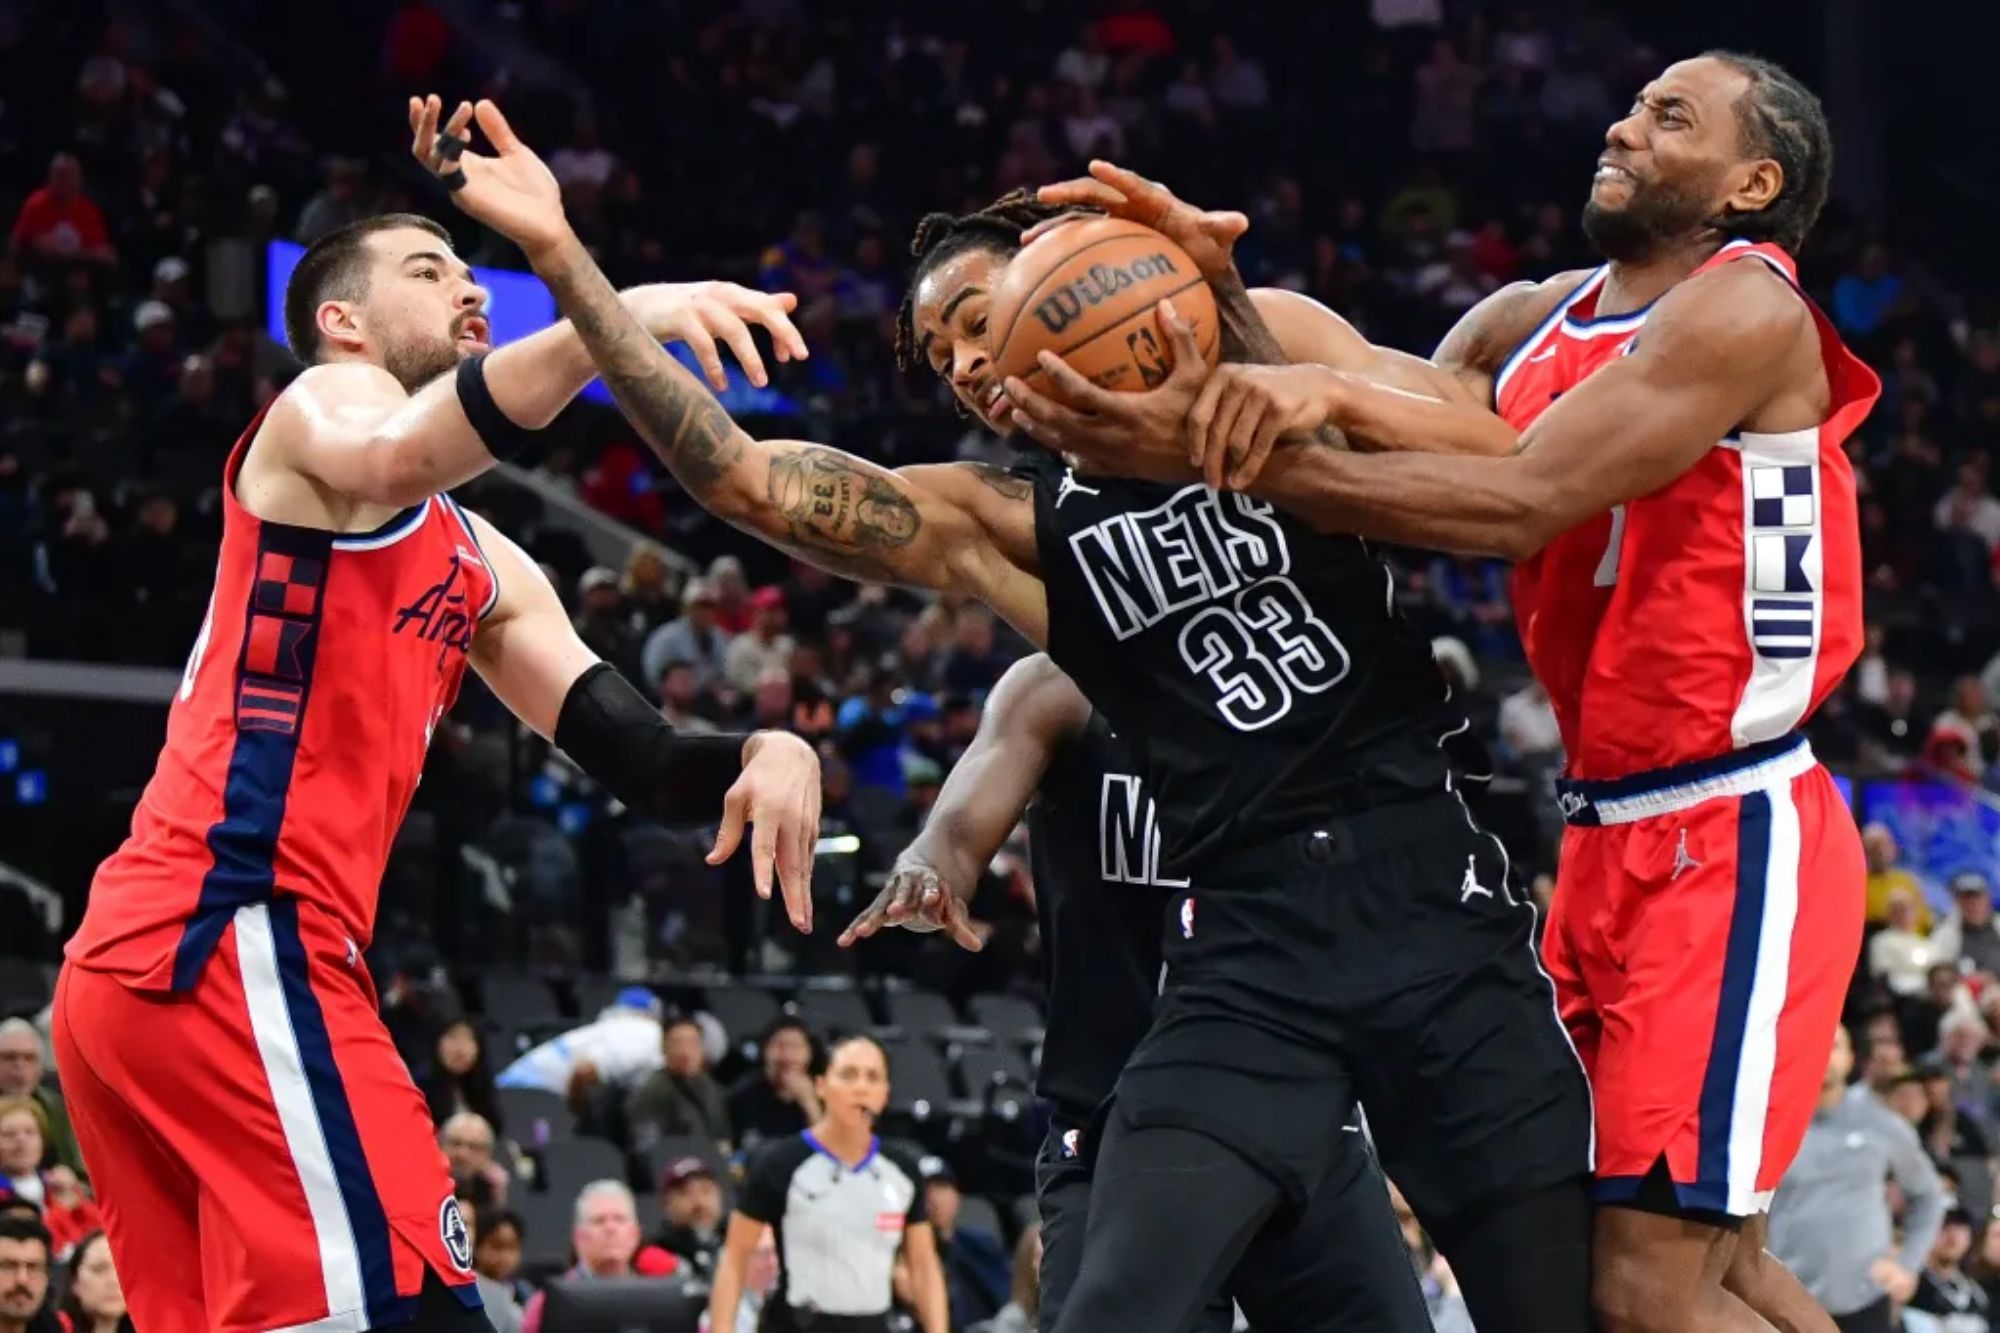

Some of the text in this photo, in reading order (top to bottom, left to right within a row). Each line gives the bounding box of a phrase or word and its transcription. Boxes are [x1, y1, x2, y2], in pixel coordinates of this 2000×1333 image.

[1033, 253, 1178, 334] Wilson
[814, 484, 835, 517] 33
[1068, 482, 1290, 642] NETS
[1178, 575, 1351, 732] 33
